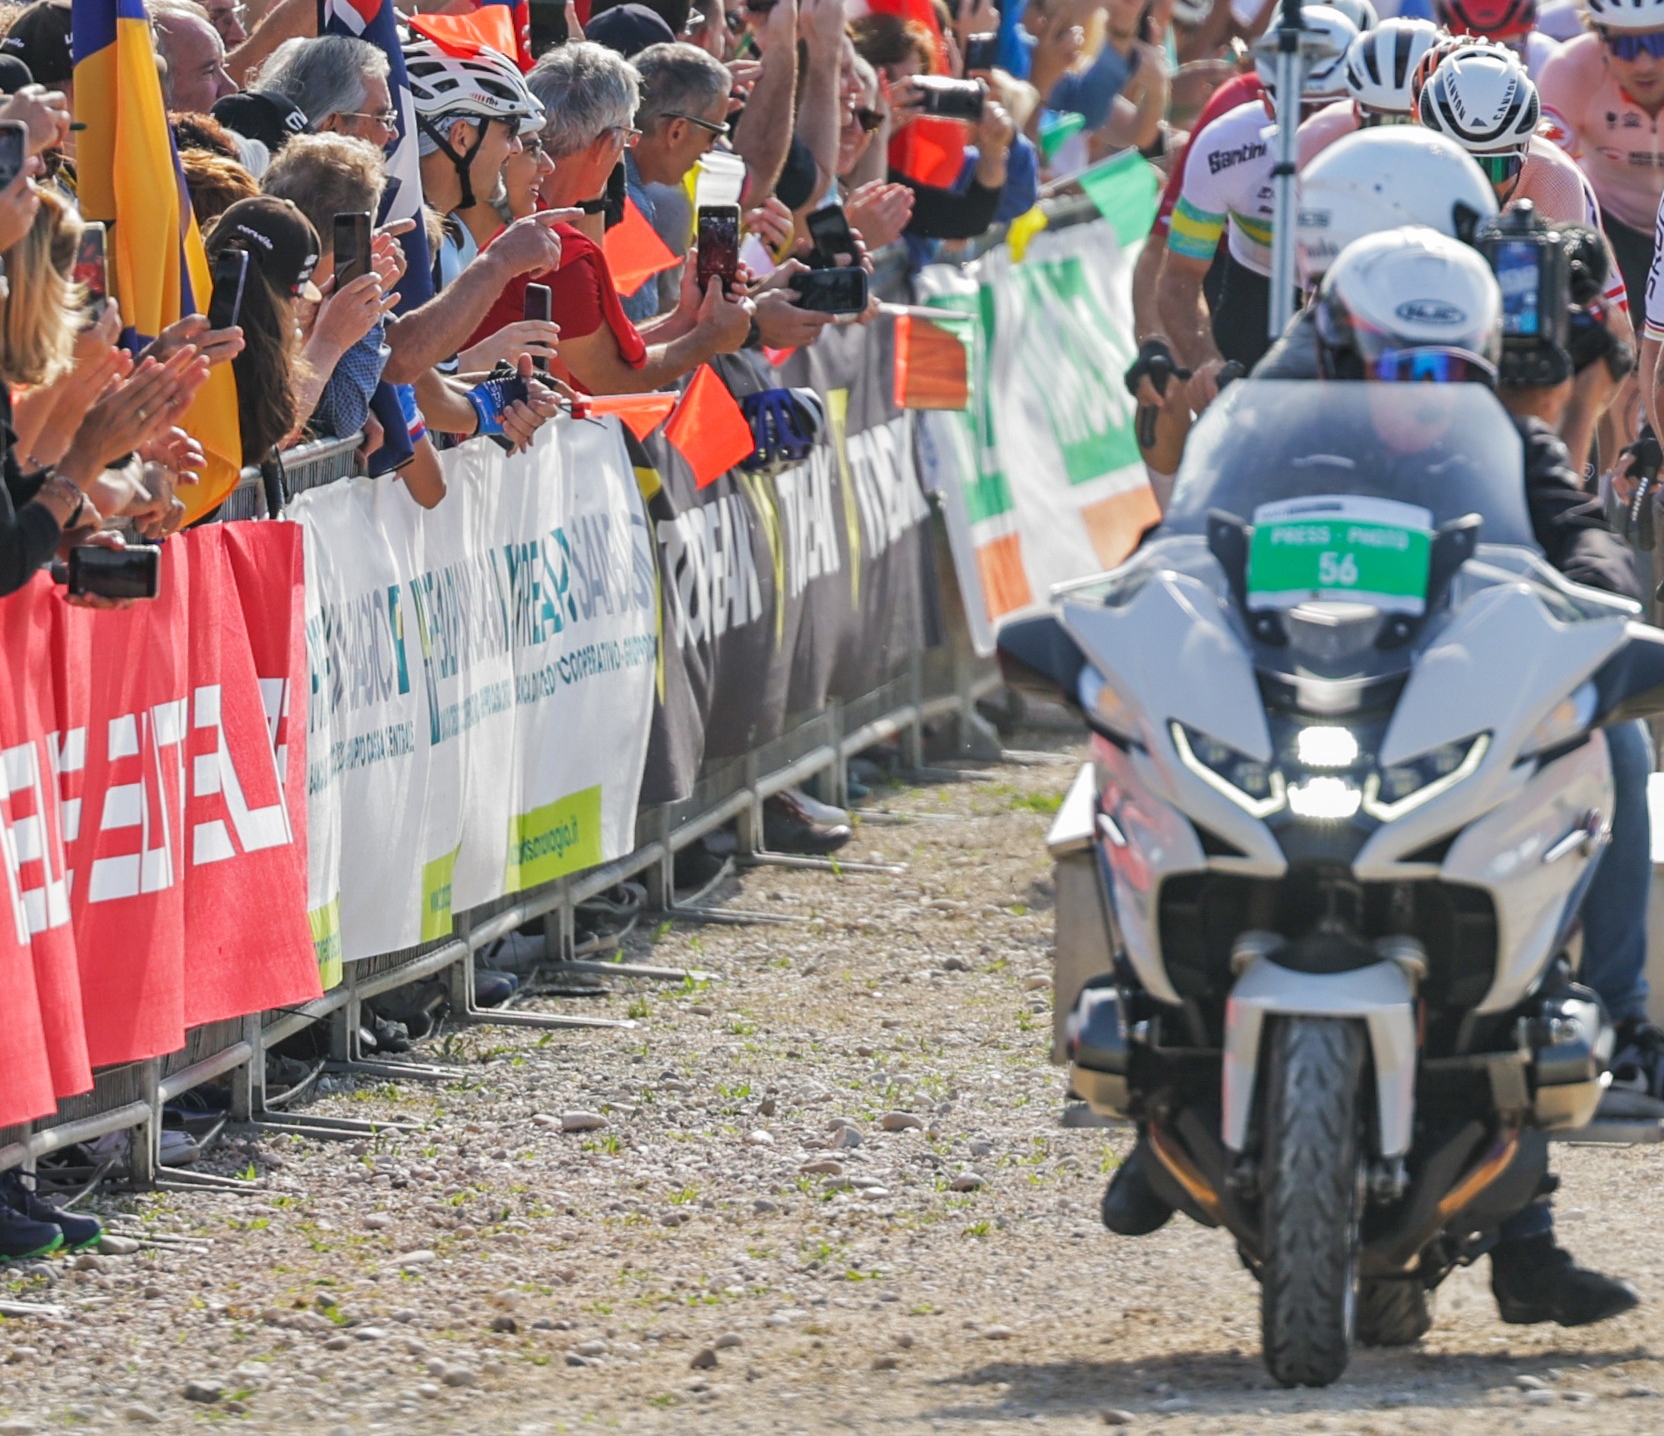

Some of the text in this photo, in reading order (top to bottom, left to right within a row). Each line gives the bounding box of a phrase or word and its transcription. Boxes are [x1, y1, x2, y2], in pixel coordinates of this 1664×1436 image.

[1445, 72, 1466, 121] CANYON
[1493, 78, 1517, 121] CANYON
[1271, 525, 1331, 546] PRESS
[1318, 551, 1359, 586] 56
